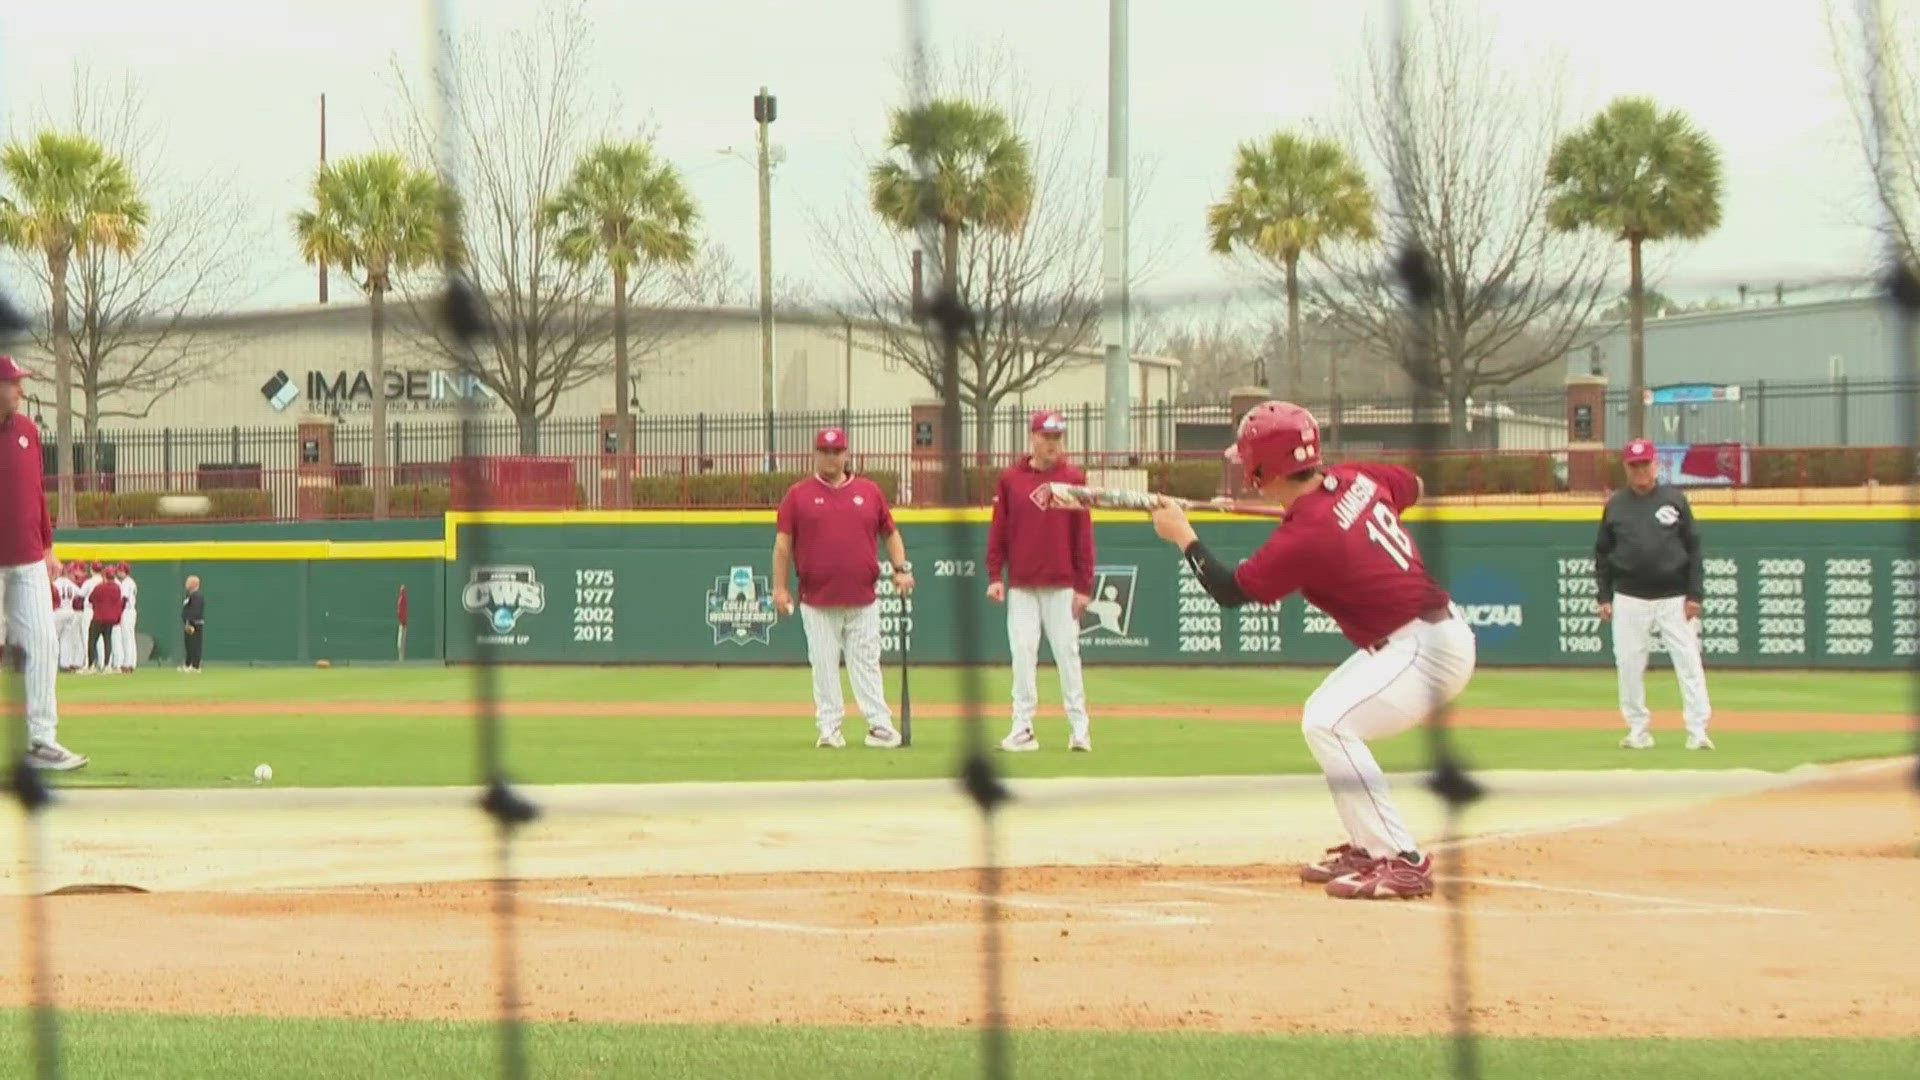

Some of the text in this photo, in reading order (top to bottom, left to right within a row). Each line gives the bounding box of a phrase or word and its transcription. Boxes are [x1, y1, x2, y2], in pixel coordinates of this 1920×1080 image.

[1365, 501, 1413, 572] 18
[934, 560, 976, 576] 2012
[1702, 559, 1738, 575] 986
[1758, 559, 1805, 575] 2000
[1825, 559, 1873, 575] 2005
[576, 569, 614, 585] 1975
[1557, 578, 1599, 594] 1975
[1702, 578, 1738, 595] 988
[1758, 578, 1802, 595] 2001
[1825, 578, 1873, 595] 2006
[465, 581, 541, 608] CWS
[575, 588, 614, 604] 1977
[574, 607, 614, 622] 2002
[1702, 598, 1738, 615] 992
[1758, 598, 1805, 615] 2002
[1825, 598, 1873, 615] 2007
[1179, 617, 1222, 632] 2003
[1239, 617, 1279, 632] 2011
[1558, 618, 1601, 632] 1977
[1703, 618, 1738, 634] 993
[1759, 618, 1805, 634] 2003
[1826, 618, 1873, 634] 2008
[574, 625, 614, 641] 2012
[1179, 635, 1222, 651] 2004
[1239, 635, 1282, 651] 2012
[1558, 636, 1602, 651] 1980
[1703, 637, 1738, 654] 998
[1759, 637, 1805, 654] 2004
[1826, 637, 1873, 654] 2009
